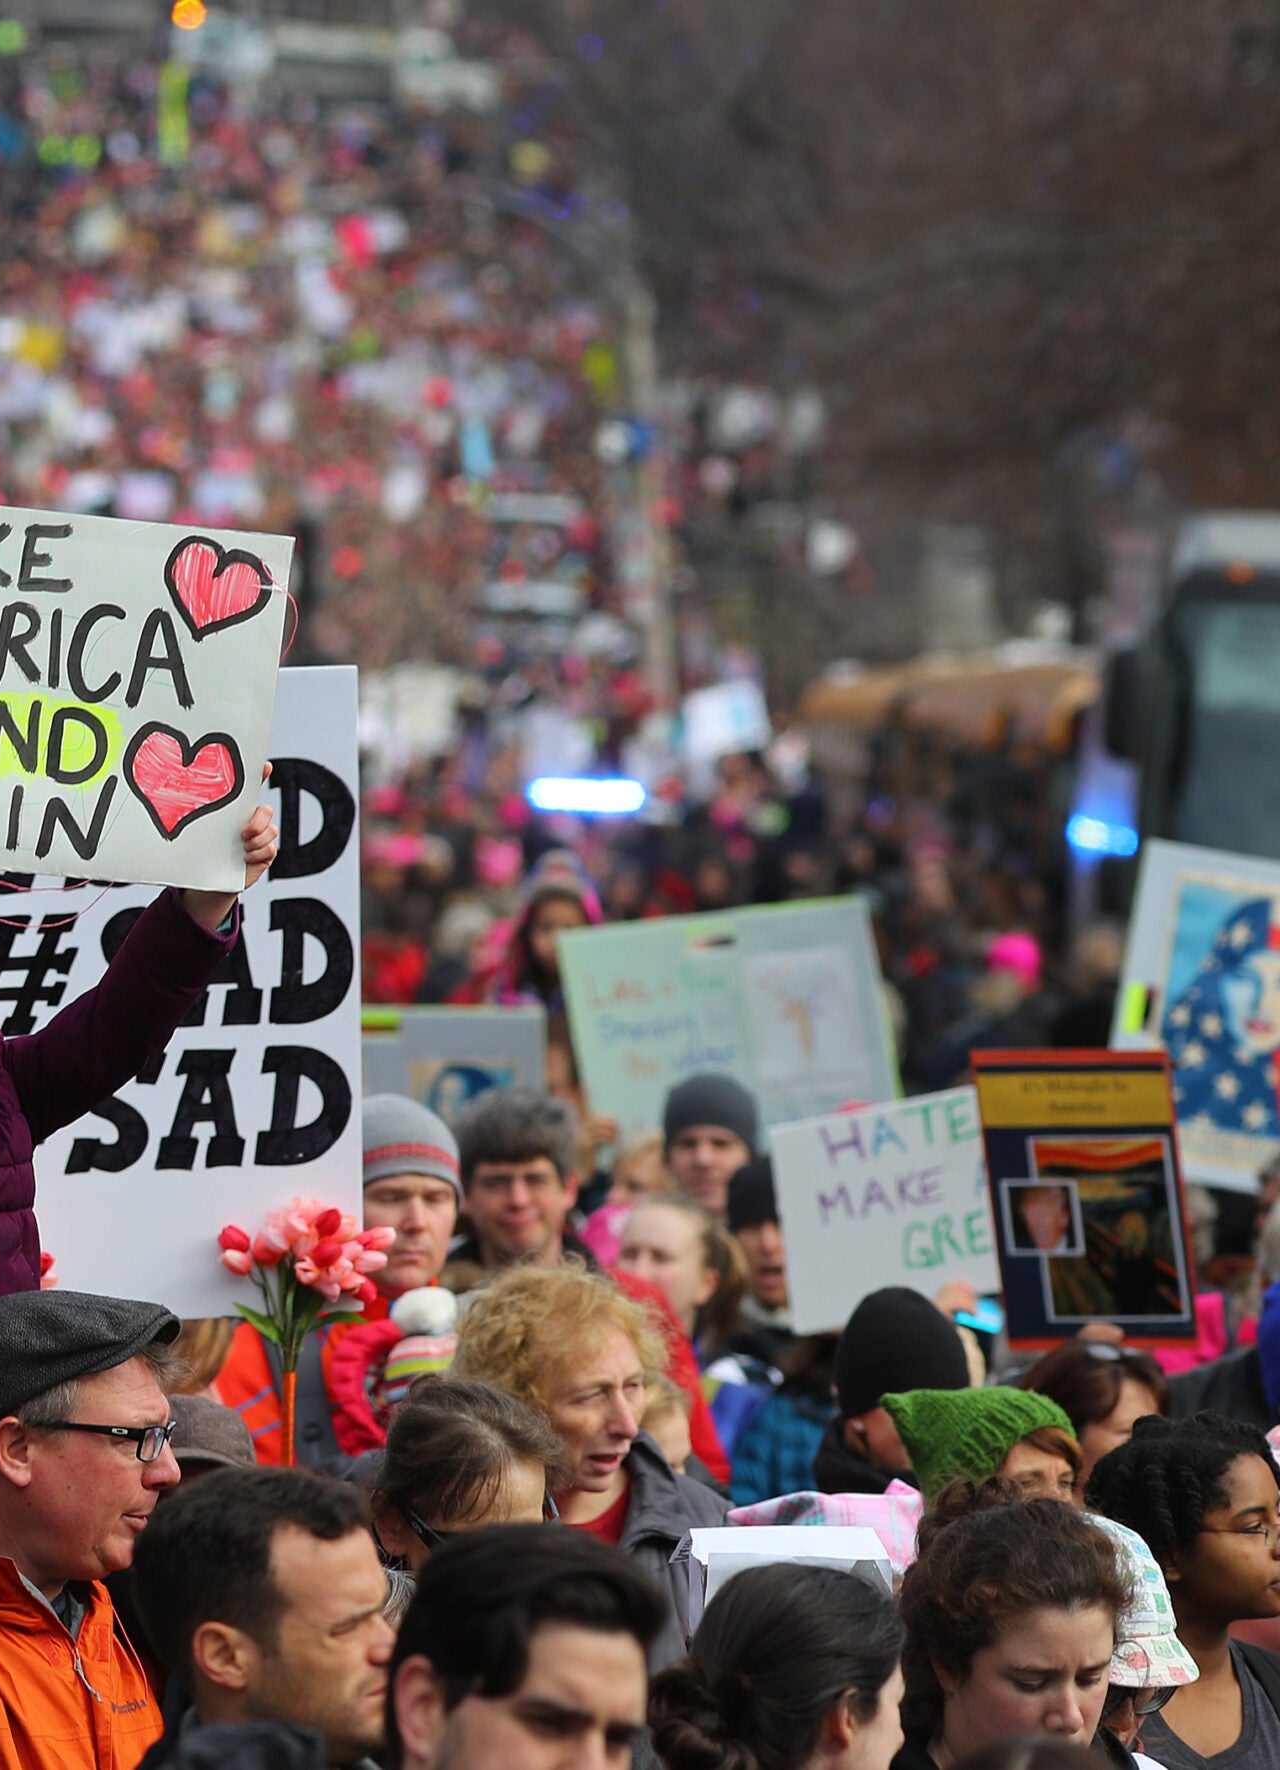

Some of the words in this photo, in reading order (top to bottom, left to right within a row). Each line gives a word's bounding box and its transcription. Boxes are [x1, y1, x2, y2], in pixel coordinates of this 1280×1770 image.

[65, 1045, 352, 1174] SAD
[820, 1097, 983, 1167] HATE
[817, 1164, 947, 1226] MAKE
